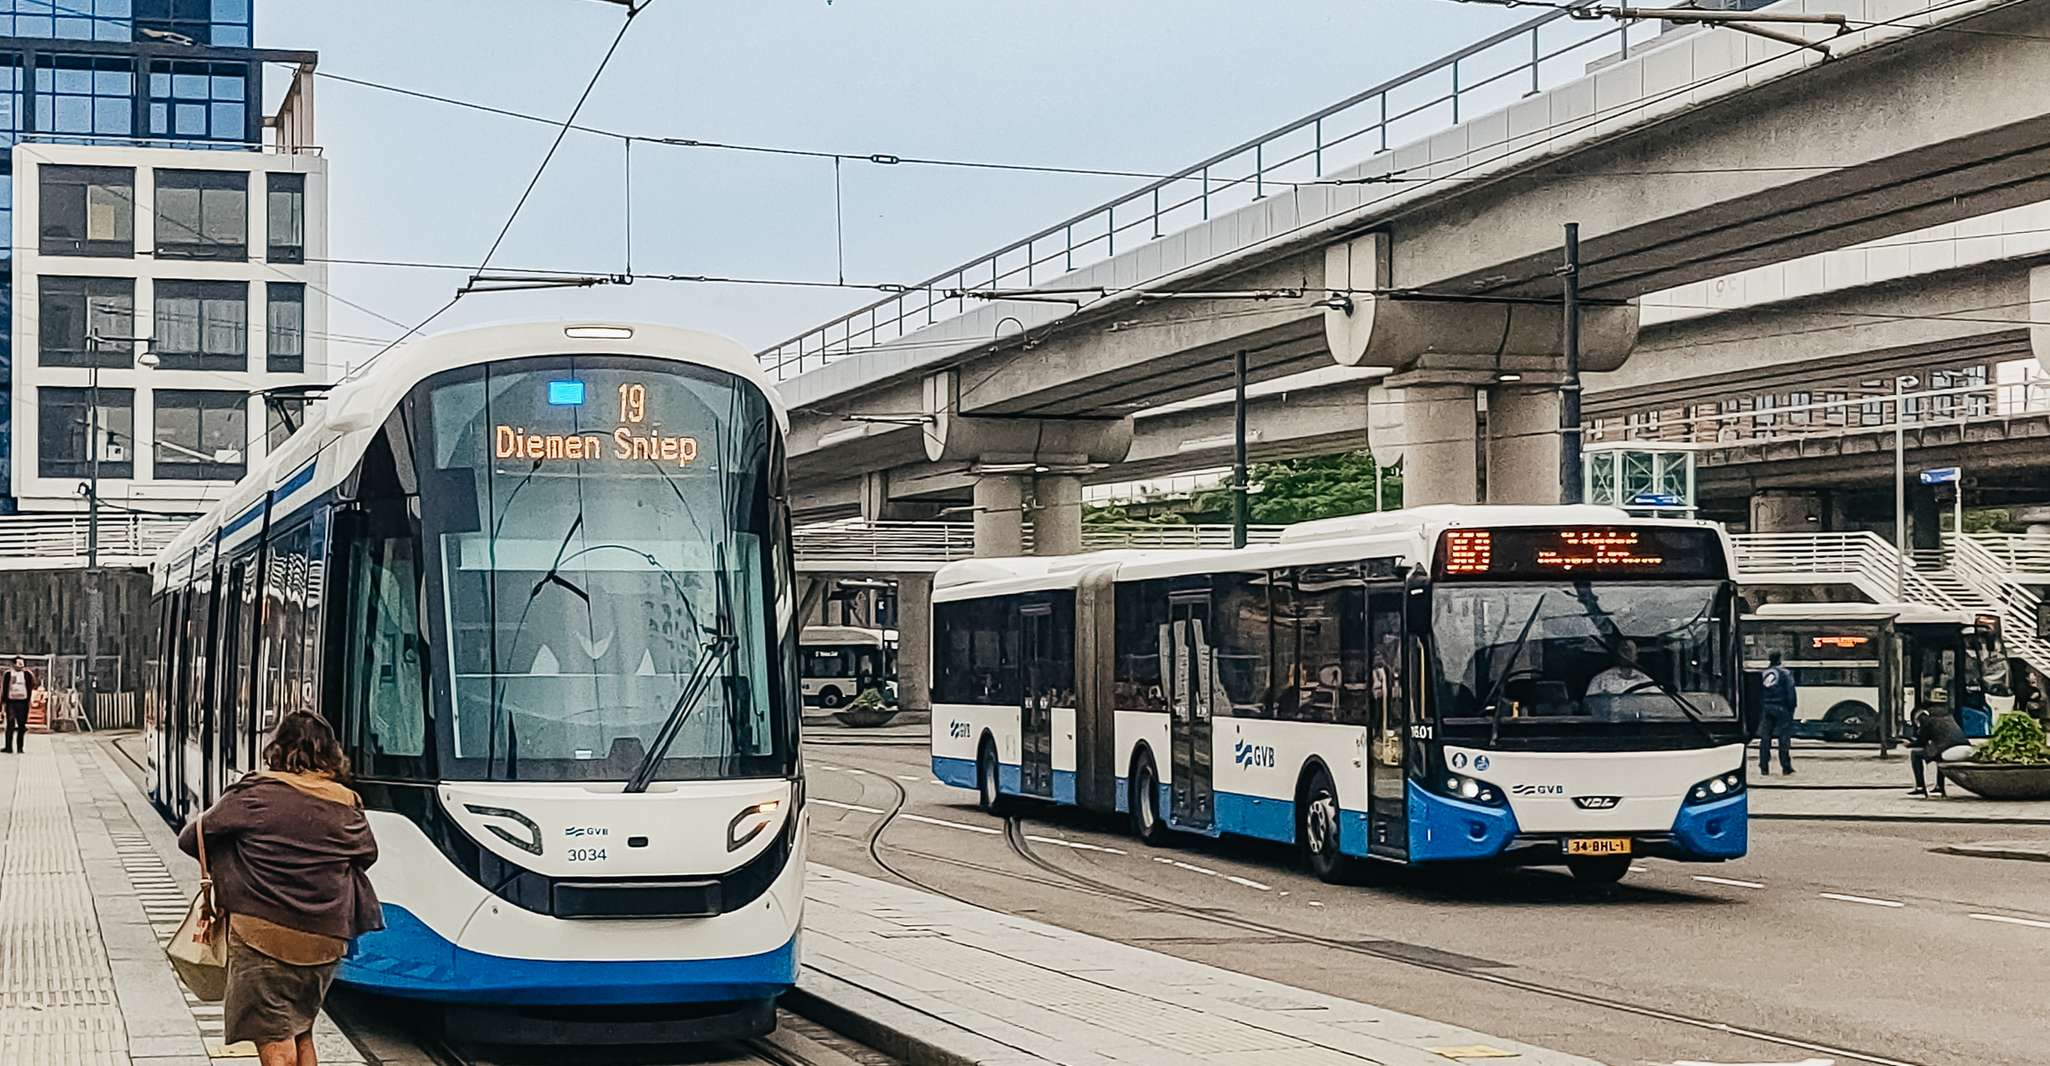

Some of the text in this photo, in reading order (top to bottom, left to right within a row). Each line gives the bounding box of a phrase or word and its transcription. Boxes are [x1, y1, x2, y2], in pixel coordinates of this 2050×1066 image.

[618, 383, 645, 422] 19
[496, 425, 697, 467] Diemen Sniep
[1254, 745, 1275, 768] GVB
[1537, 785, 1563, 794] GVB
[568, 848, 607, 861] 3034
